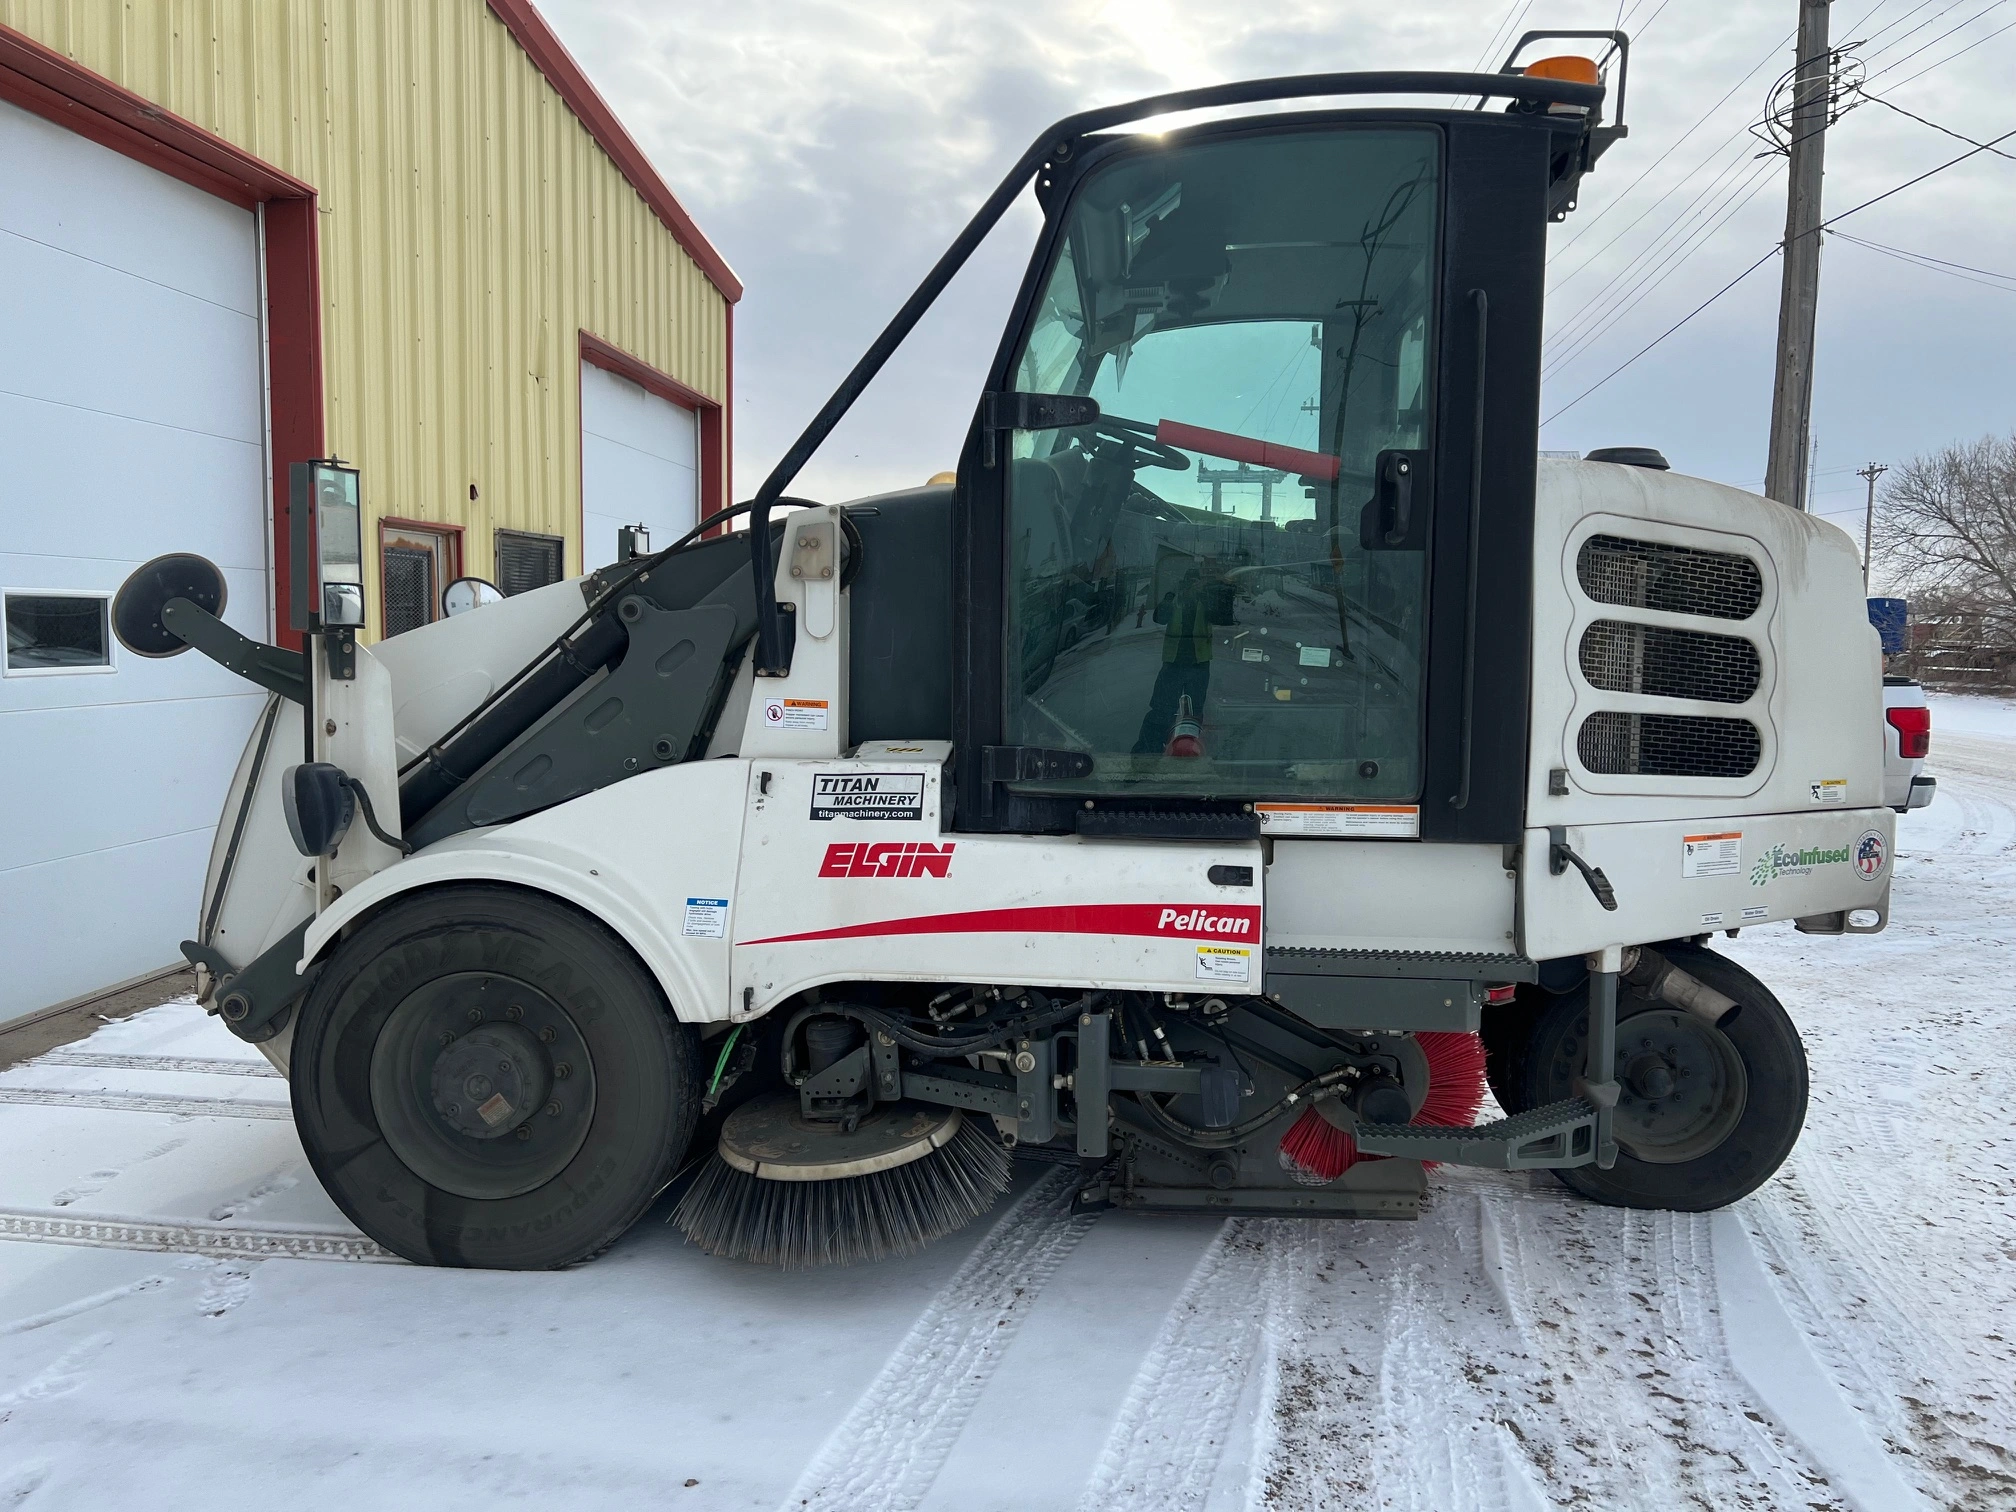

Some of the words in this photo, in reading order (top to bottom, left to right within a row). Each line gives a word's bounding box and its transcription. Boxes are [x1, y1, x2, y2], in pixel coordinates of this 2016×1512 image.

[820, 778, 880, 792] TITAN
[833, 795, 917, 806] MACHINERY
[818, 843, 956, 878] ELGIN
[1773, 845, 1850, 868] EcoInfused
[1779, 867, 1813, 877] Technology
[1158, 908, 1250, 934] Pelican
